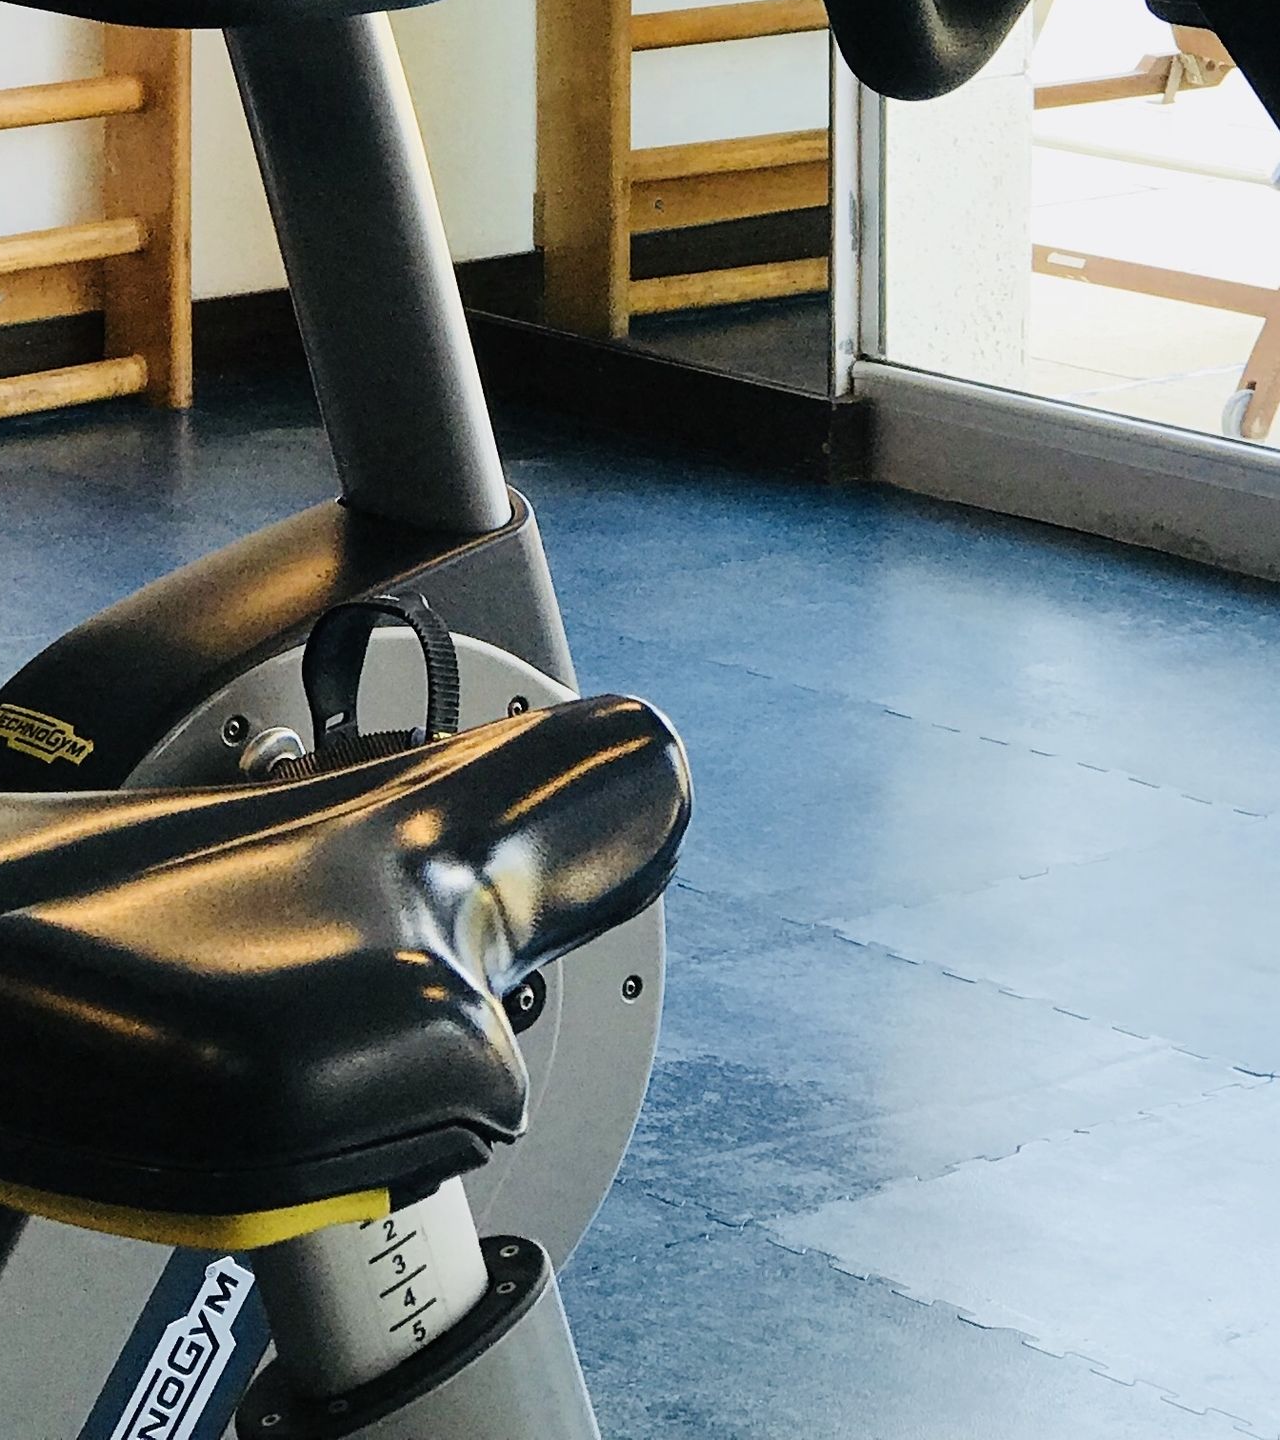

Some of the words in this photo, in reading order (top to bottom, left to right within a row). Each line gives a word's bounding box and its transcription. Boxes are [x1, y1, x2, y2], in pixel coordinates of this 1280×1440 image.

[382, 1219, 398, 1242] 2
[391, 1253, 407, 1275] 3
[403, 1286, 418, 1308] 4
[412, 1319, 427, 1342] 5
